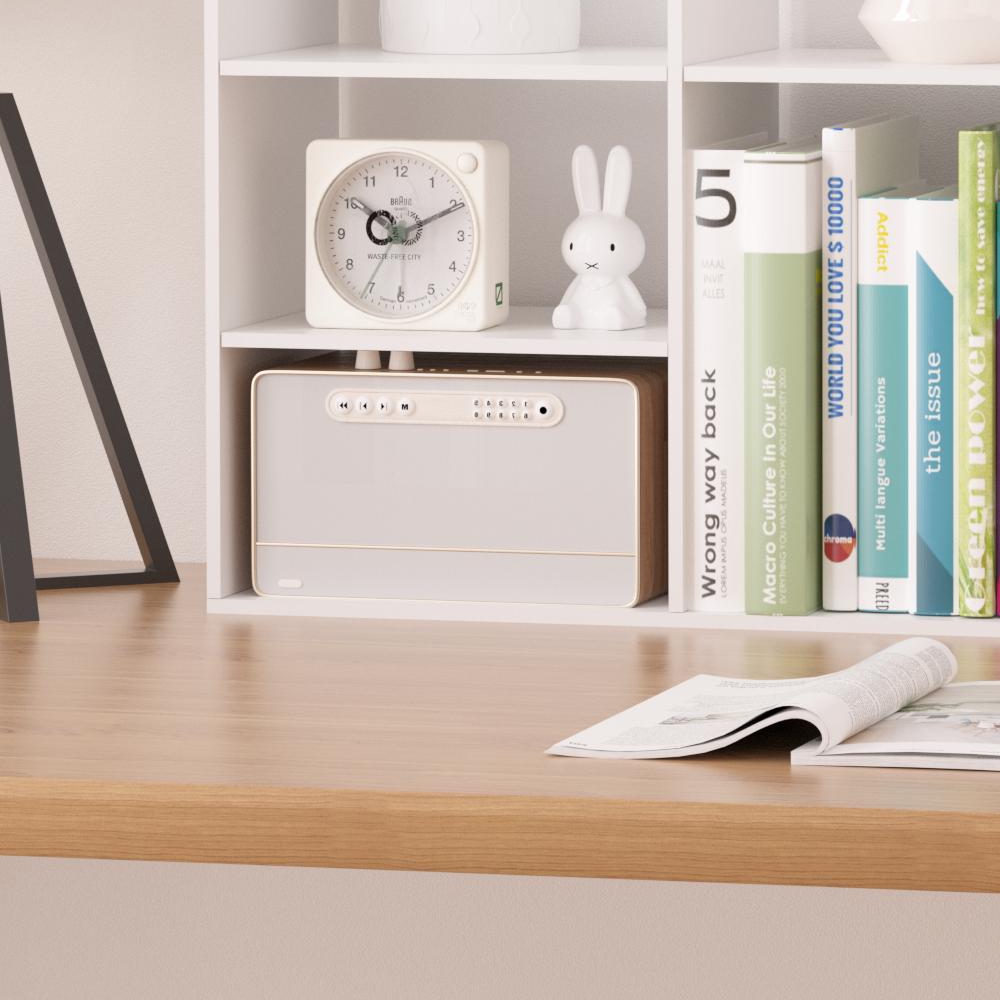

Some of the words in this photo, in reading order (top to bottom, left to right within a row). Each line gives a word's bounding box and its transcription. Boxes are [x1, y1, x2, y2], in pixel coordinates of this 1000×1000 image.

[363, 176, 376, 188] 11
[394, 166, 409, 178] 12
[977, 136, 986, 203] energy
[696, 168, 737, 228] 5
[828, 176, 844, 235] 10000
[337, 228, 346, 240] 9
[457, 230, 465, 242] 3
[877, 212, 889, 273] Addict
[977, 207, 986, 249] save
[346, 258, 354, 271] 8
[448, 261, 457, 272] 4
[828, 258, 844, 303] LOVE
[976, 255, 986, 272] to
[368, 281, 376, 294] 7
[427, 284, 436, 296] 5
[975, 278, 986, 315] how
[828, 309, 844, 348] YOU
[762, 366, 777, 398] Life
[828, 353, 844, 419] WORLD
[925, 352, 941, 421] issue
[968, 326, 987, 465] power
[701, 369, 716, 439] back
[762, 404, 777, 439] Our
[875, 377, 886, 453] Variations
[763, 444, 777, 462] In
[923, 430, 941, 474] the
[705, 448, 720, 503] way
[875, 458, 890, 509] langue
[763, 467, 778, 537] Culture
[824, 535, 853, 544] chroma
[875, 514, 886, 551] Multi
[965, 477, 986, 614] Green
[702, 513, 720, 598] Wrong
[762, 542, 778, 605] Macro
[875, 582, 890, 611] PREED
